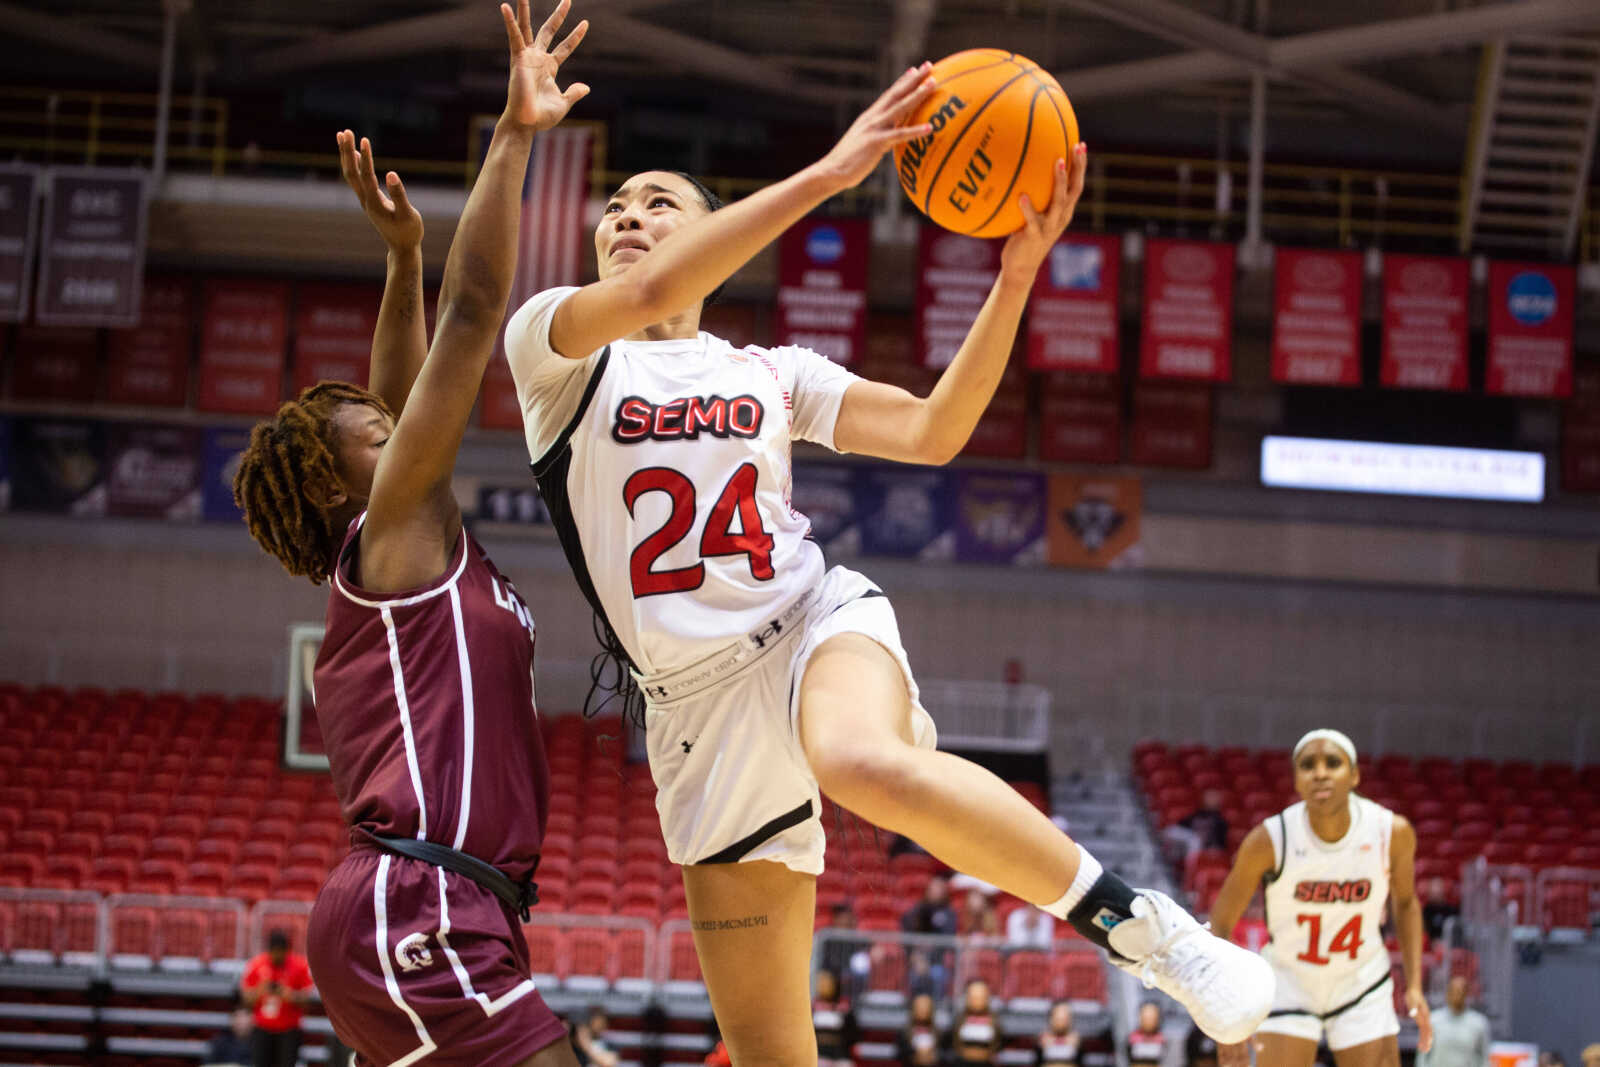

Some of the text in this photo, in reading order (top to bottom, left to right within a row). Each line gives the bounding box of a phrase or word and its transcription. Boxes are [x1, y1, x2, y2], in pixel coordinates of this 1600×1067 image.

[612, 394, 764, 444] SEMO
[622, 462, 775, 600] 24
[1294, 879, 1372, 904] SEMO
[1297, 913, 1364, 966] 14
